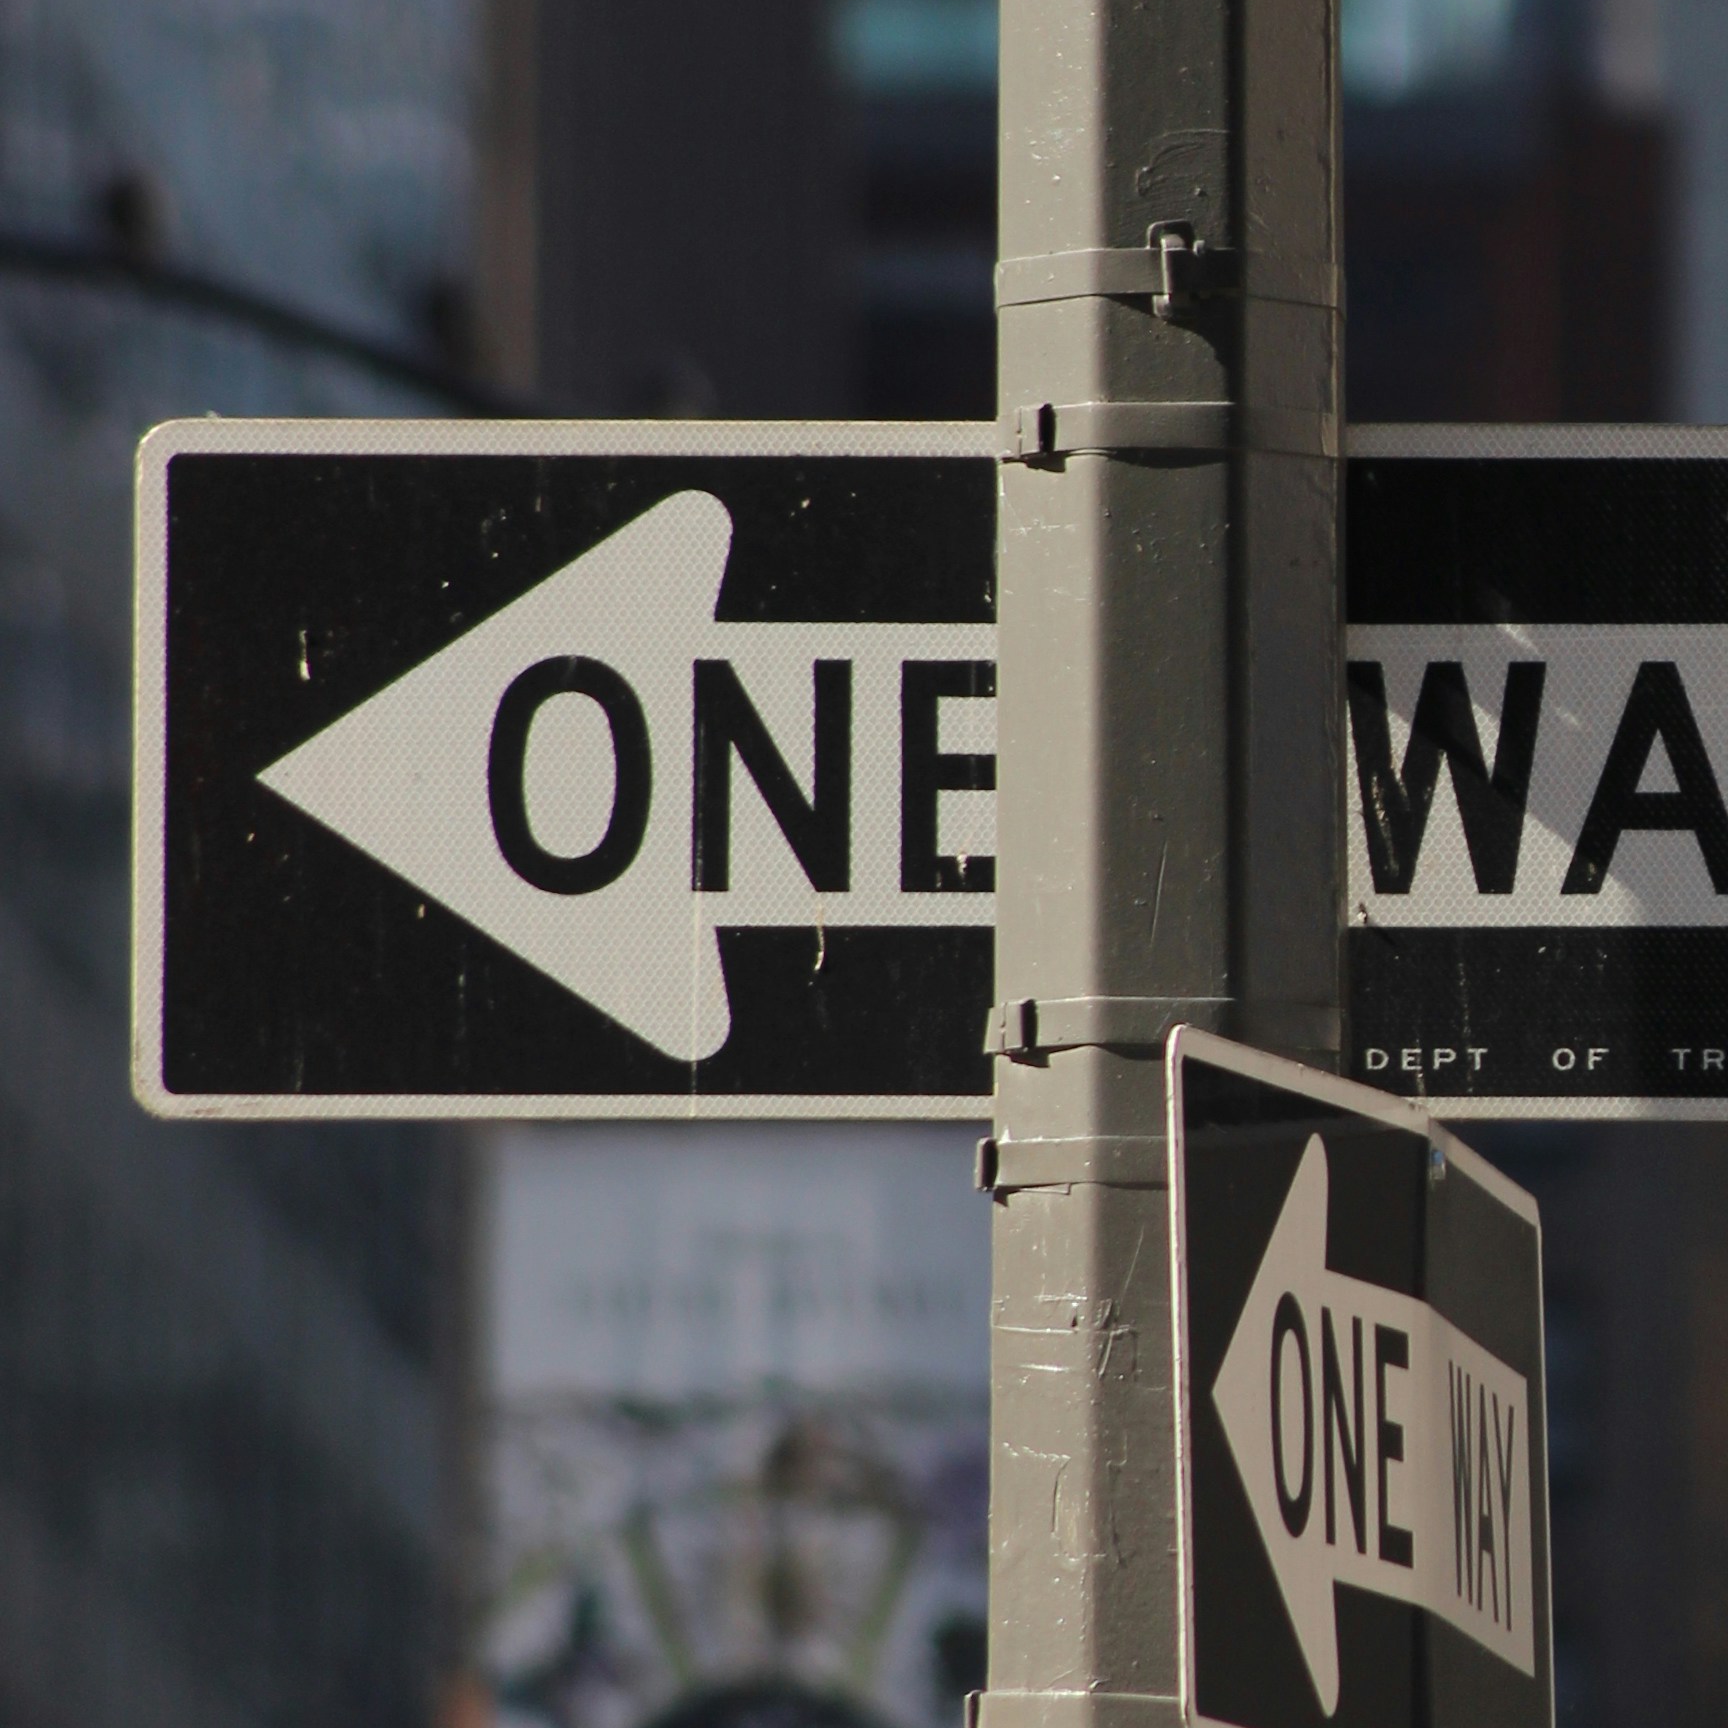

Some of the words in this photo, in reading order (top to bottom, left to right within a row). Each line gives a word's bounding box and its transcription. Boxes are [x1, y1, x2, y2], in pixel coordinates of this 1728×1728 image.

[487, 655, 996, 895] ONE
[1365, 1047, 1488, 1071] DEPT
[1552, 1047, 1609, 1071] OF
[1269, 1290, 1415, 1570] ONE
[1447, 1358, 1516, 1633] WAY
